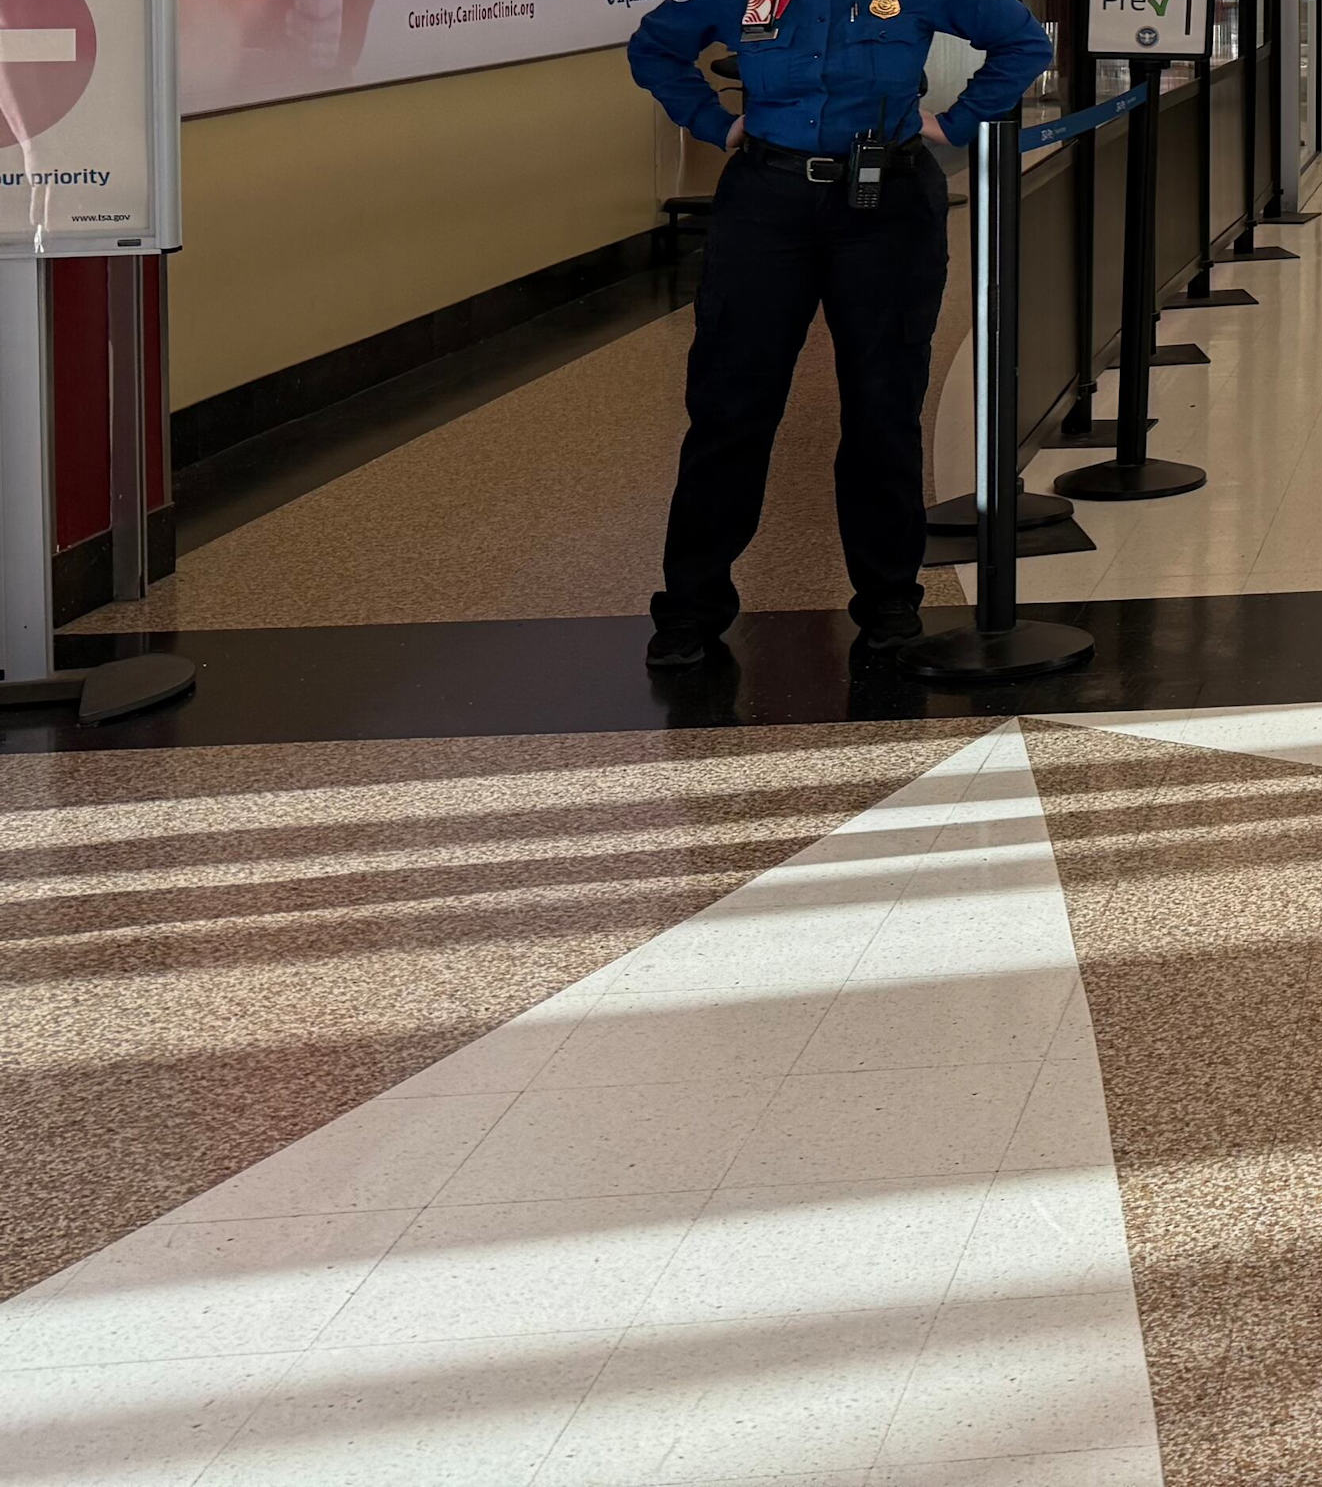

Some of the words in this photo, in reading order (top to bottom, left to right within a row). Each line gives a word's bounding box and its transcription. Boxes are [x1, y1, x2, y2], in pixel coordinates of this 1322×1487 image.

[408, 0, 535, 29] Curiosity.CarilionClinic.org
[31, 167, 111, 188] priority
[71, 212, 131, 224] www.tsa.gov
